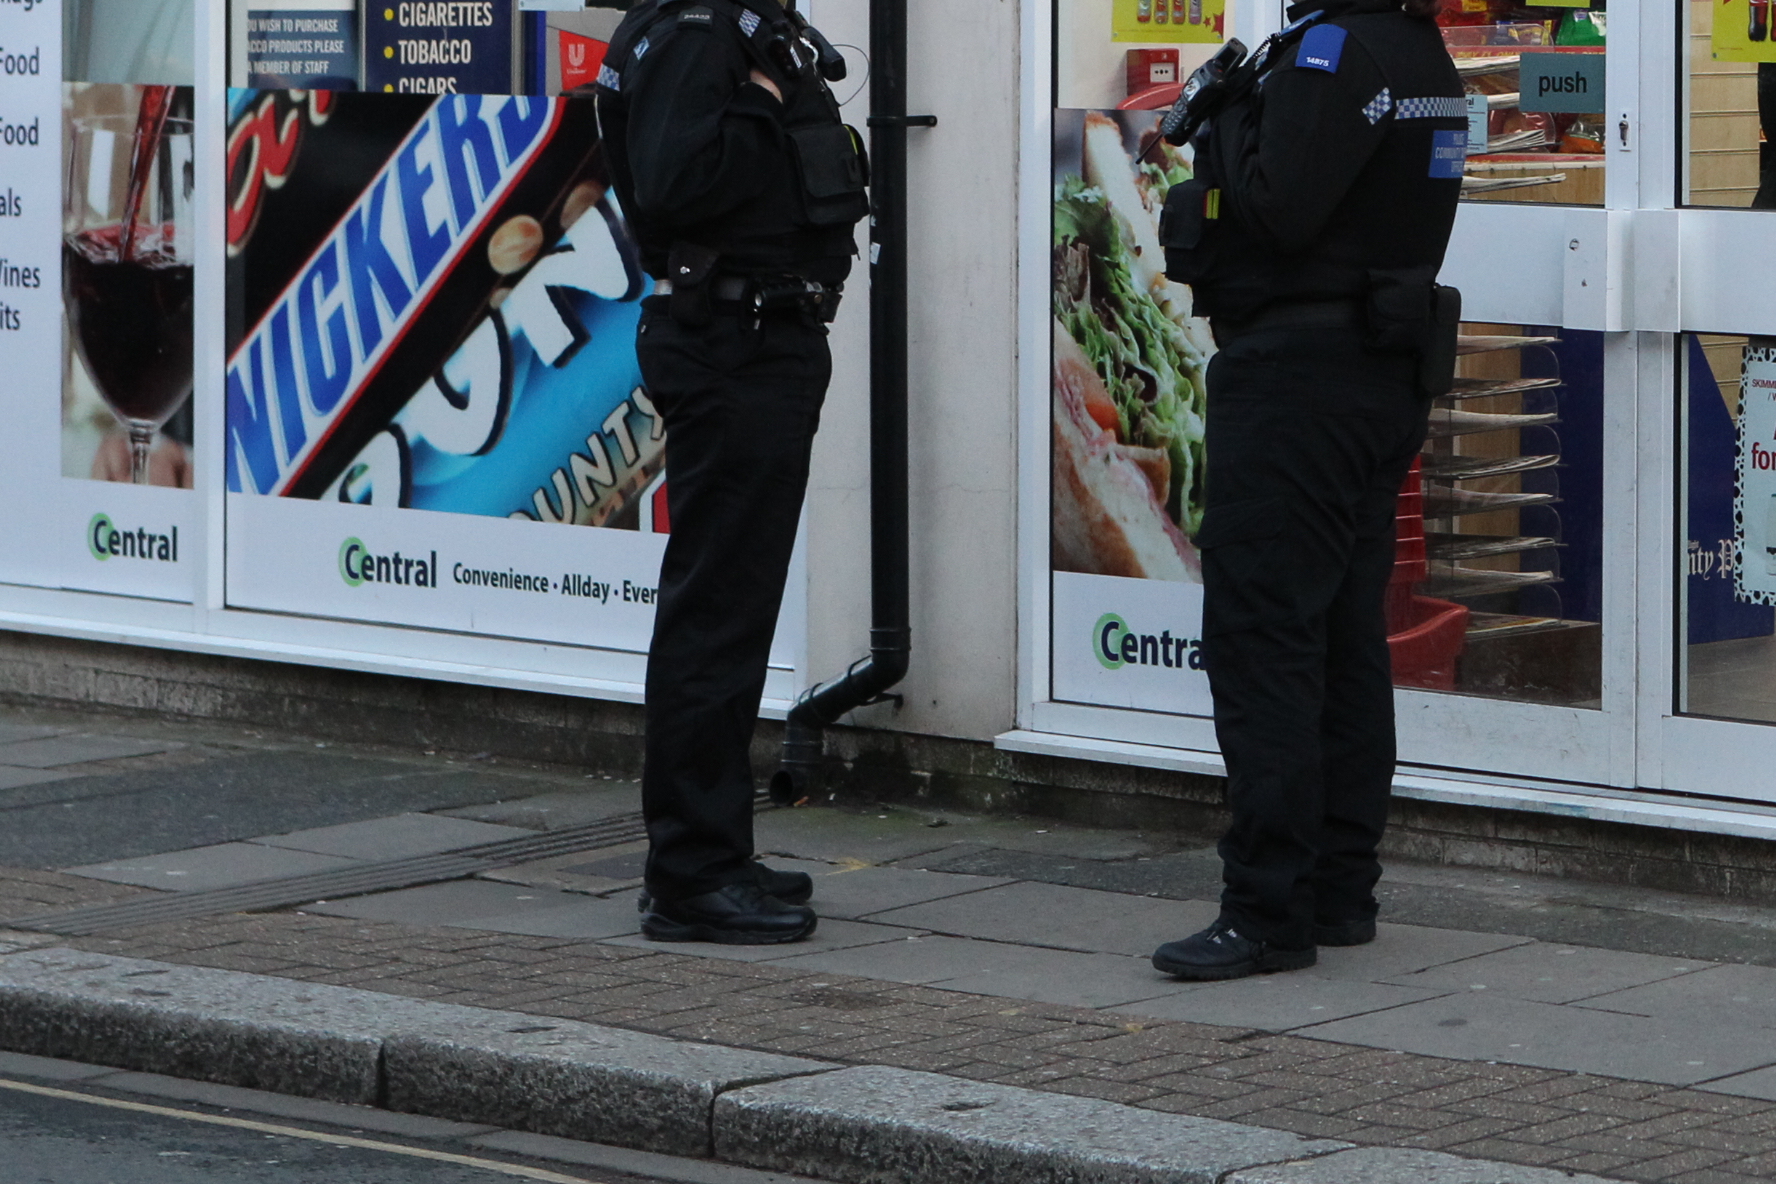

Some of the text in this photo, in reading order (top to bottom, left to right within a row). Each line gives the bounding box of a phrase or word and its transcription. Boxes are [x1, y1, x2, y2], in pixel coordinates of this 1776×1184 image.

[258, 19, 339, 33] WISH TO PURCHASE
[399, 2, 493, 27] CIGARETTES
[269, 40, 344, 53] PRODUCTS PLEASE
[398, 39, 472, 65] TOBACCO
[254, 61, 329, 74] MEMBER OF STAFF
[1538, 71, 1587, 97] push
[94, 520, 178, 562] Central
[346, 544, 437, 588] Central
[453, 562, 549, 593] Convenience
[561, 573, 610, 605] Allday
